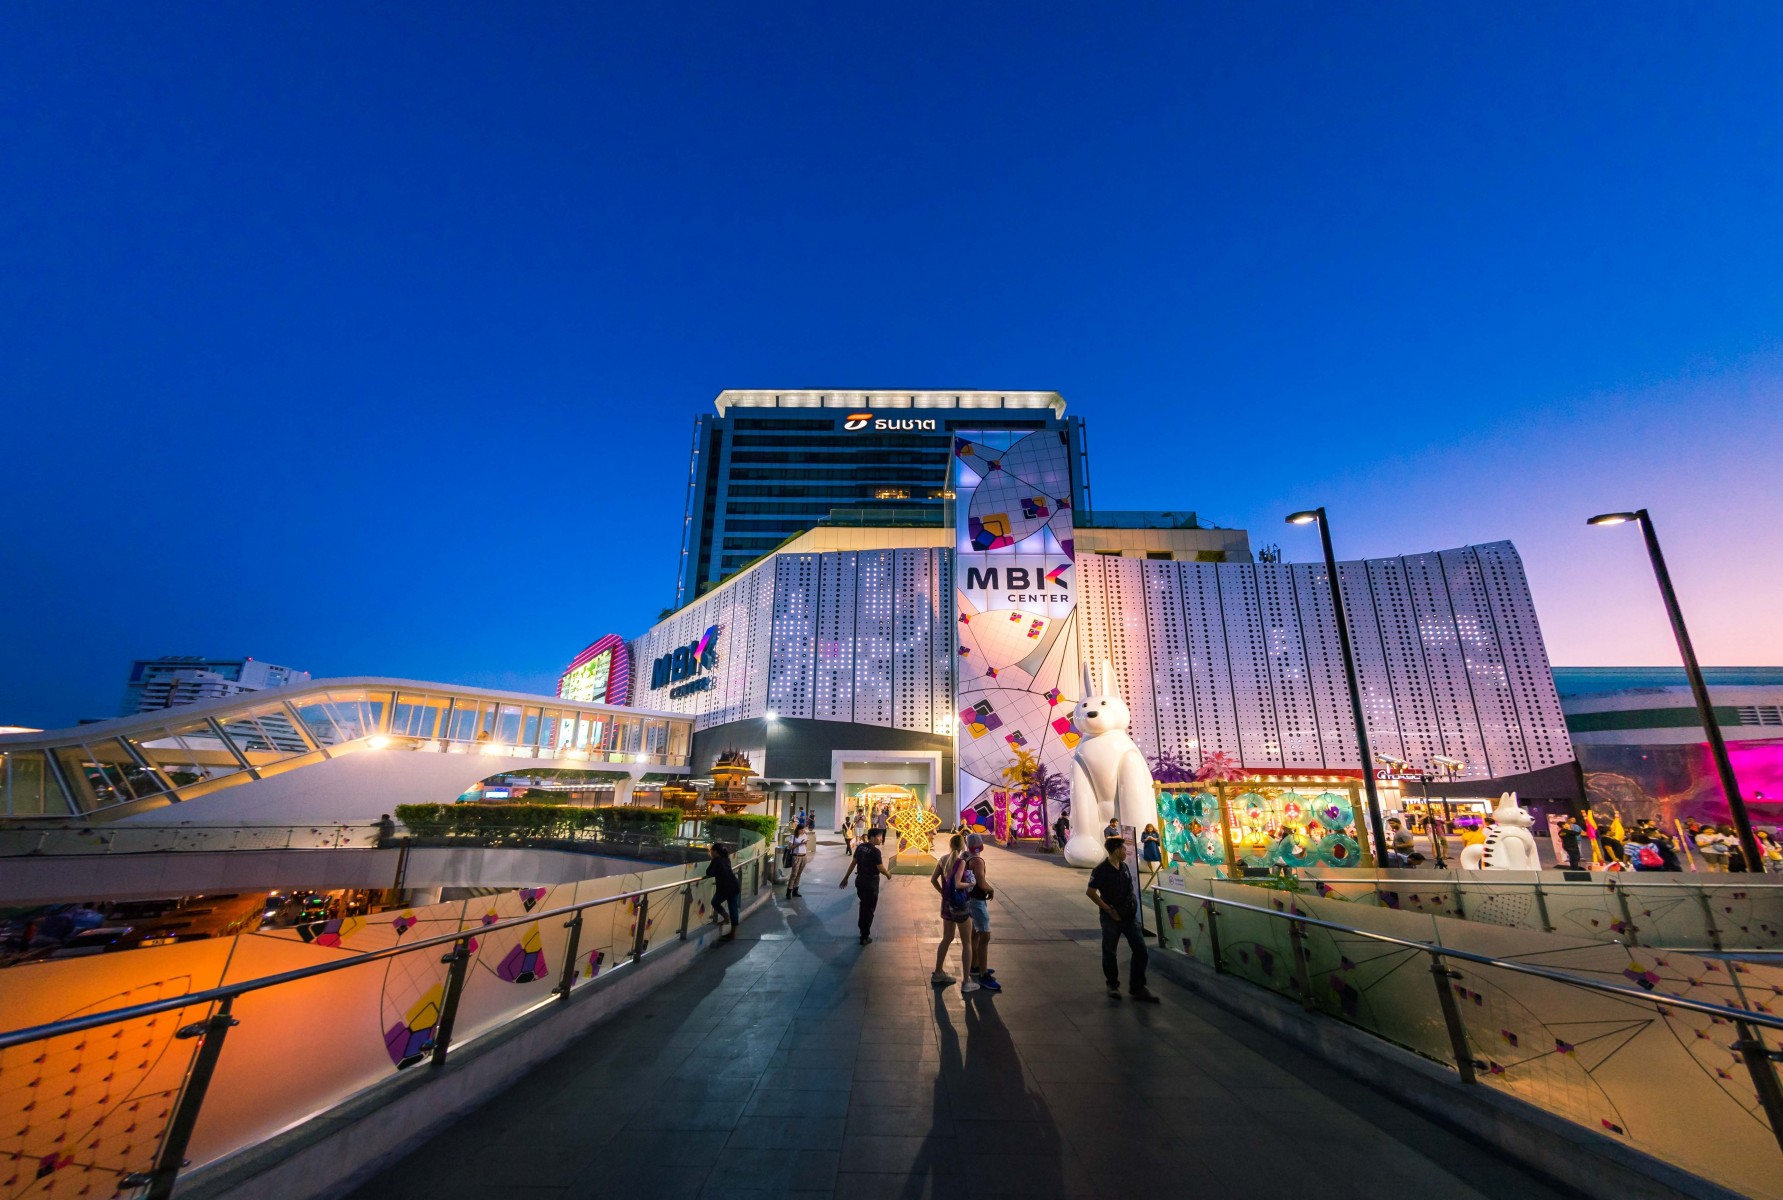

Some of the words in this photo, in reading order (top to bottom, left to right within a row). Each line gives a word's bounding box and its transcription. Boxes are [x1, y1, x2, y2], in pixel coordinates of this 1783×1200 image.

[875, 418, 936, 430] ธนชาต
[967, 564, 1073, 590] MBK
[1007, 594, 1069, 603] CENTER
[650, 624, 718, 690] MBK
